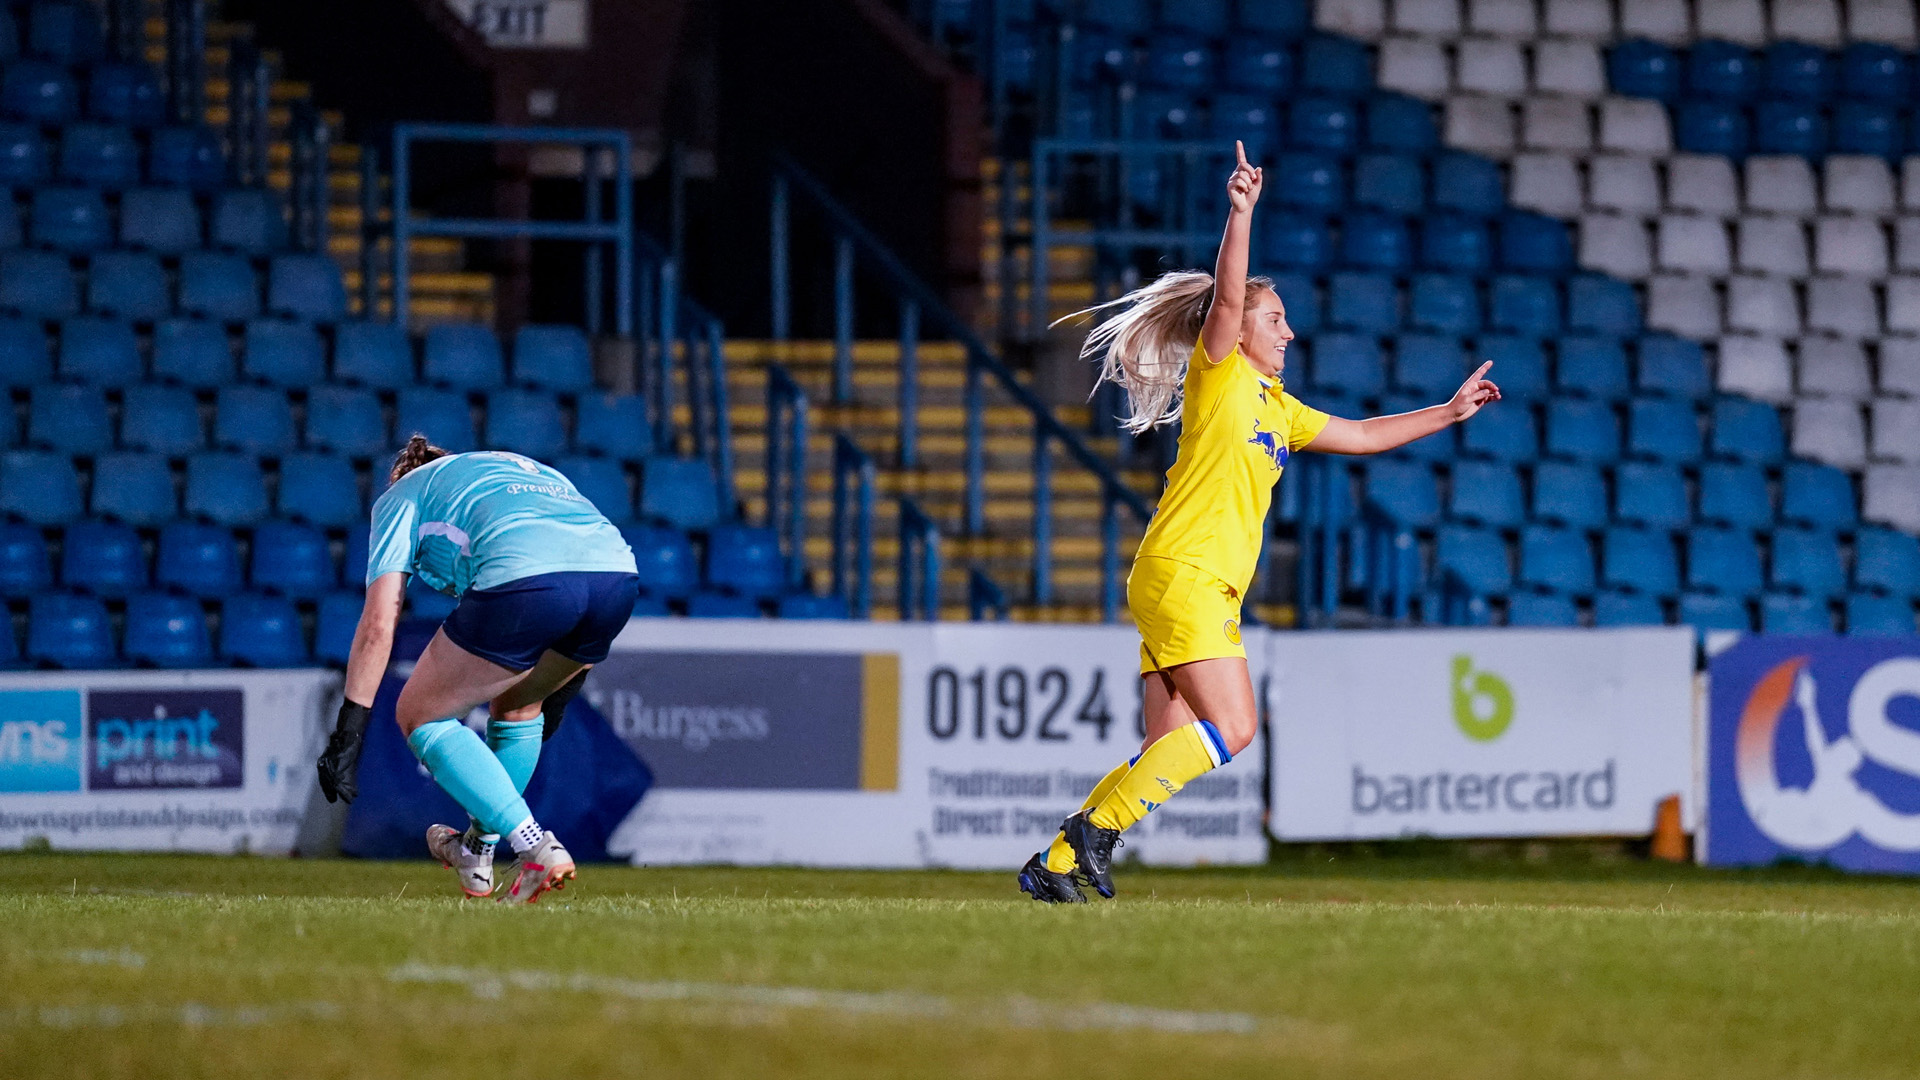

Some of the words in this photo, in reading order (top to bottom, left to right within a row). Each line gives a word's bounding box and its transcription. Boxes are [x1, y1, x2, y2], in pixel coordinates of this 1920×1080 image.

[471, 2, 545, 35] EXIT
[507, 482, 569, 497] Premier
[612, 688, 770, 750] Burgess
[927, 665, 1113, 740] 01924
[96, 704, 220, 770] print
[113, 763, 151, 785] and
[153, 763, 222, 789] design
[928, 767, 1050, 797] Traditional
[1352, 758, 1616, 813] bartercard
[933, 806, 1004, 835] Direct
